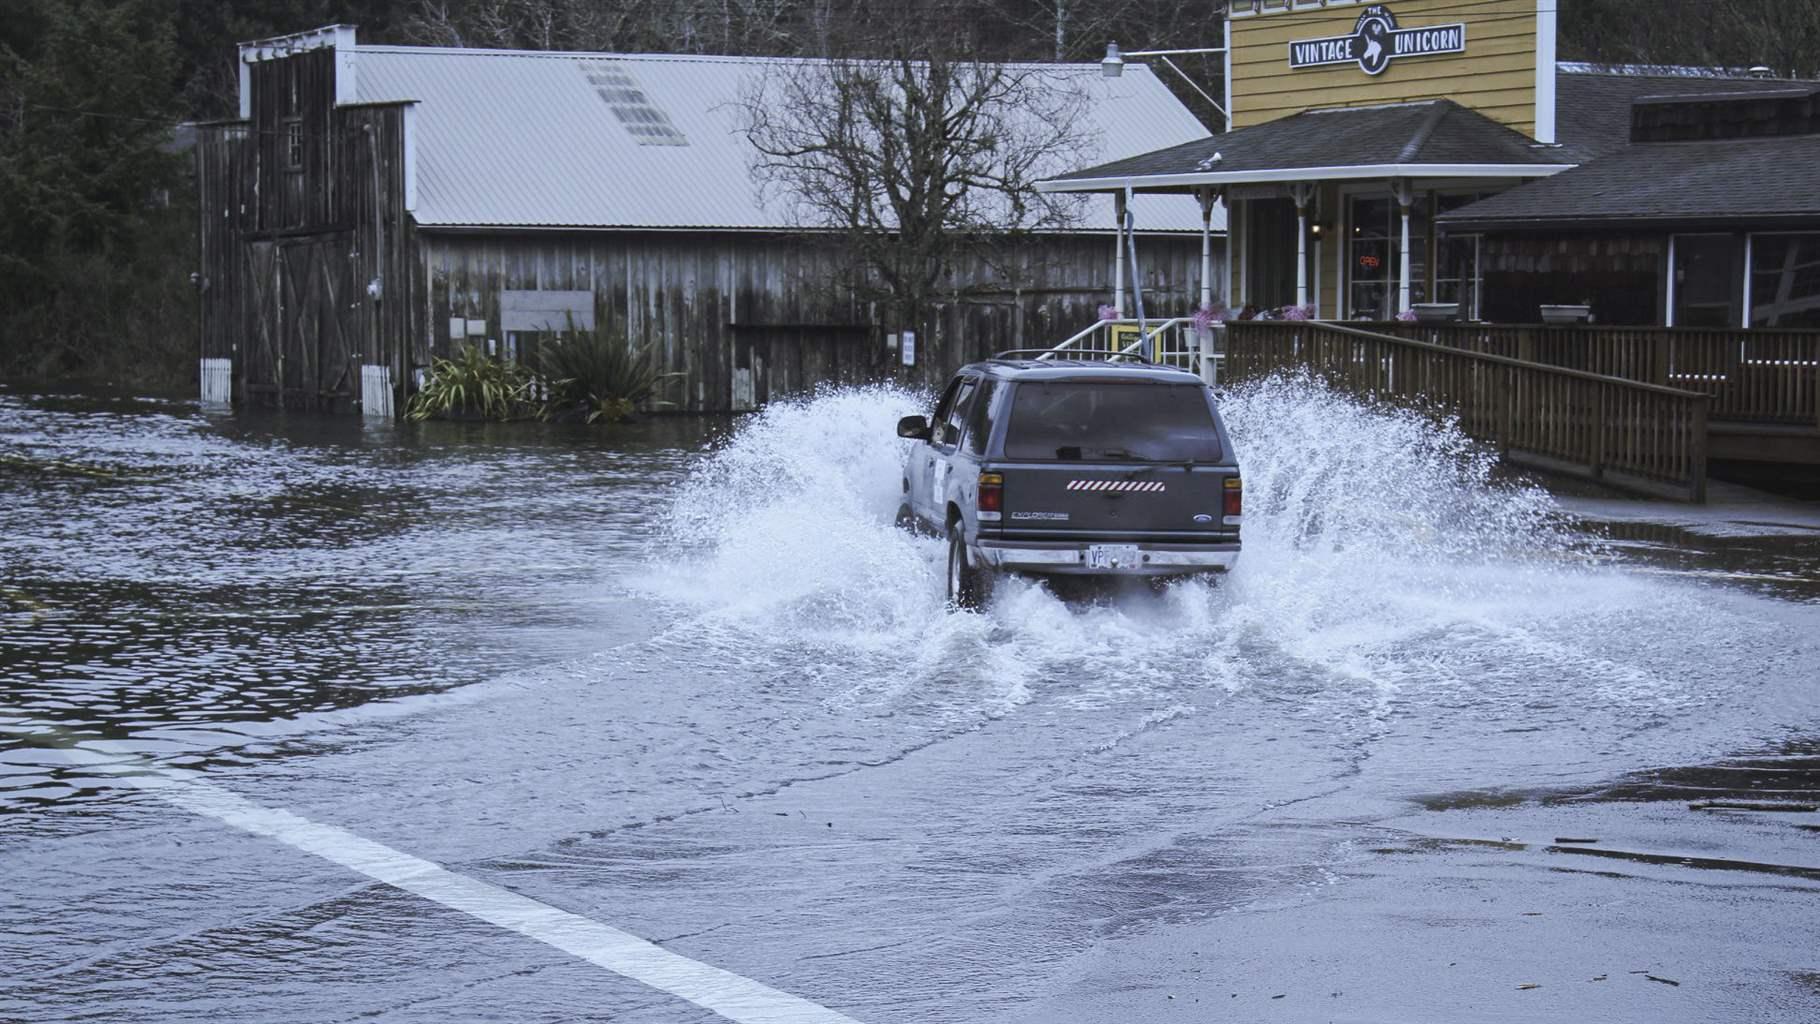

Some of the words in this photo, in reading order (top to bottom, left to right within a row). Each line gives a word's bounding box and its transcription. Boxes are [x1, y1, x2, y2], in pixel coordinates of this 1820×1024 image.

[1368, 6, 1381, 15] THE
[1296, 39, 1353, 64] VINTAGE
[1395, 29, 1459, 54] UNICORN
[1360, 255, 1380, 267] OPEN
